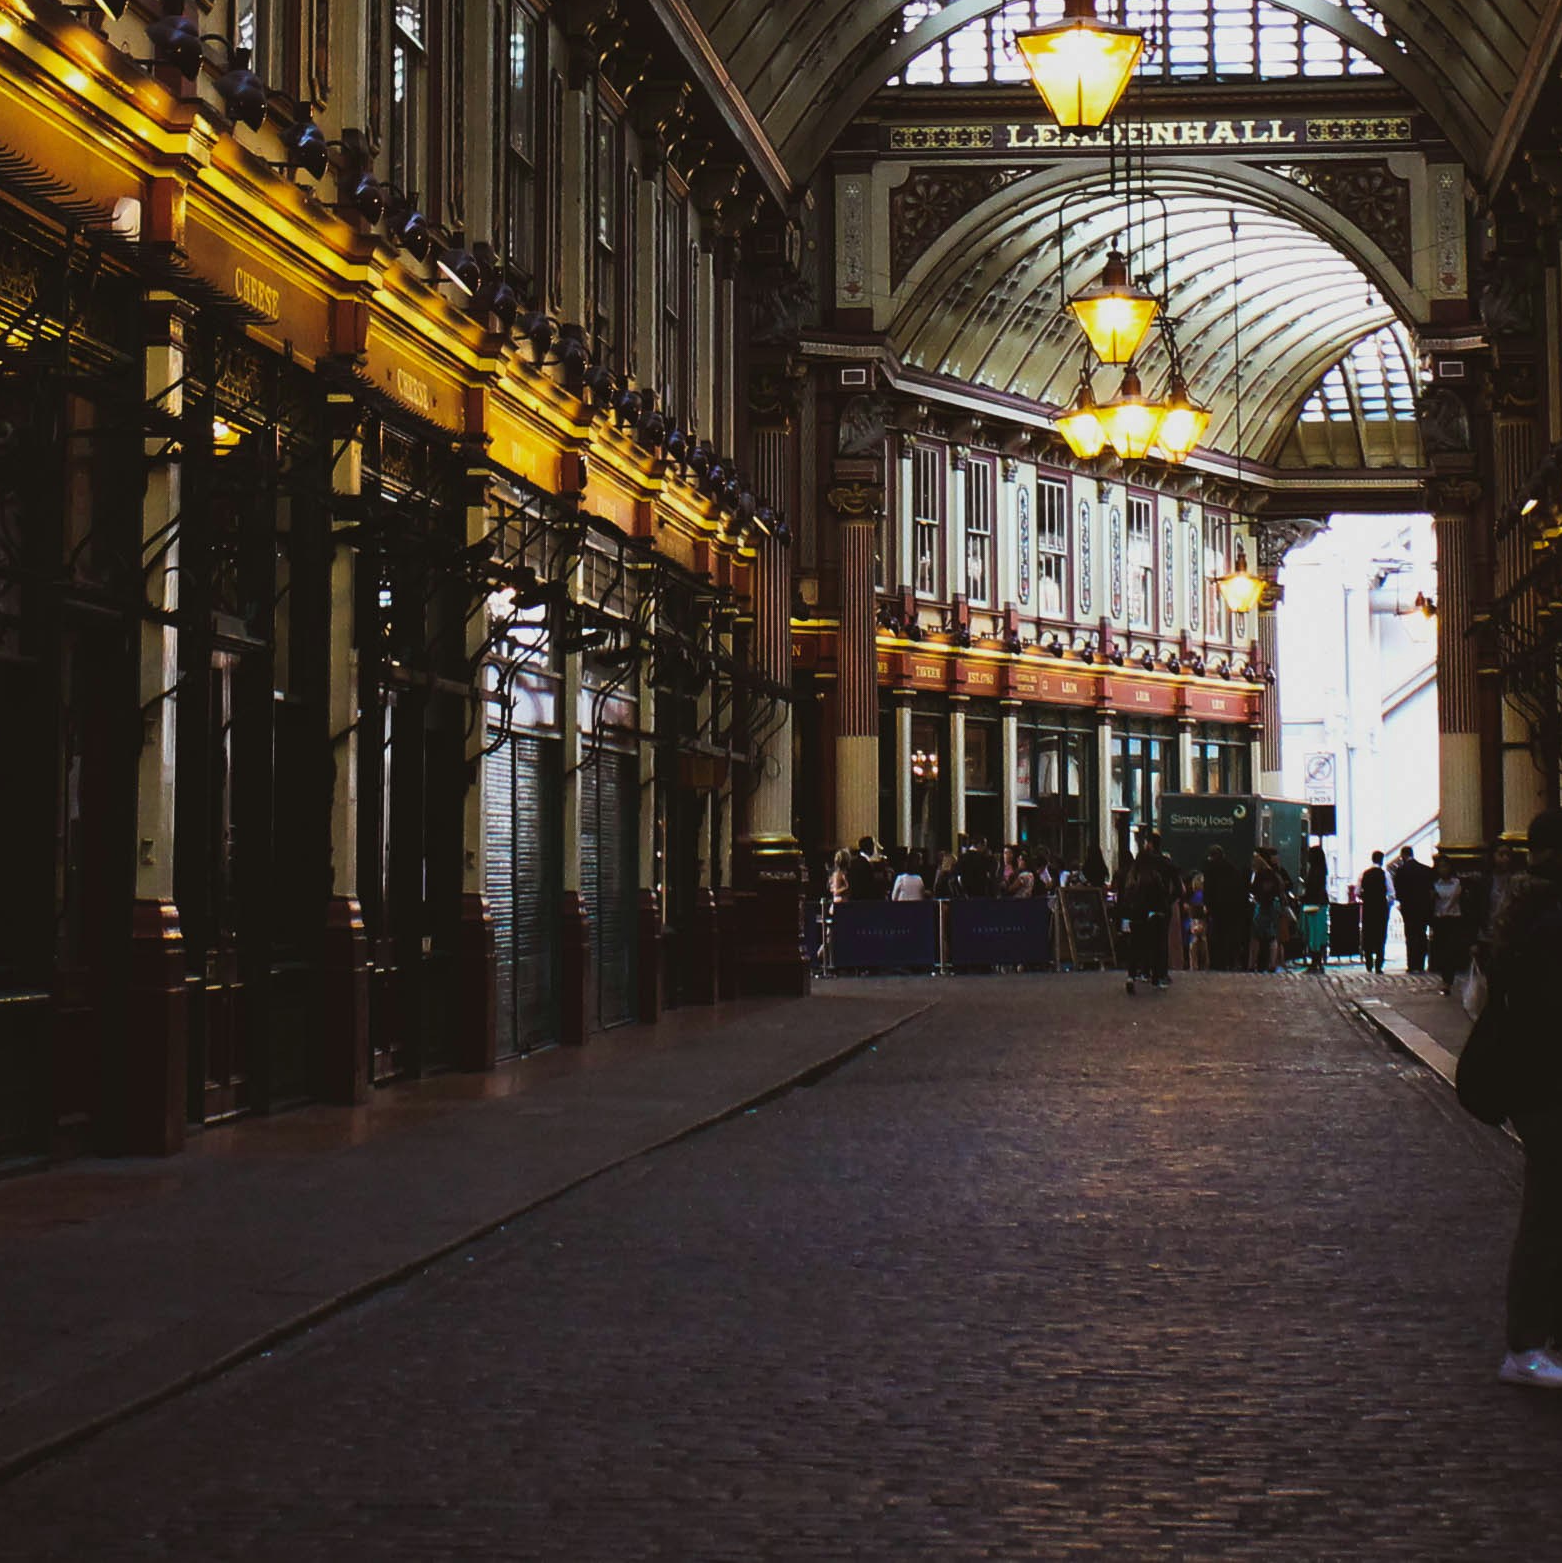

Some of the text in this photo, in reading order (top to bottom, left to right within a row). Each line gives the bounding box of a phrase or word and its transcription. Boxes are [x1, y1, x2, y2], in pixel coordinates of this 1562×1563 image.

[234, 266, 281, 321] CHEESE
[397, 367, 431, 412] CHEESE
[1170, 813, 1207, 828] Simply
